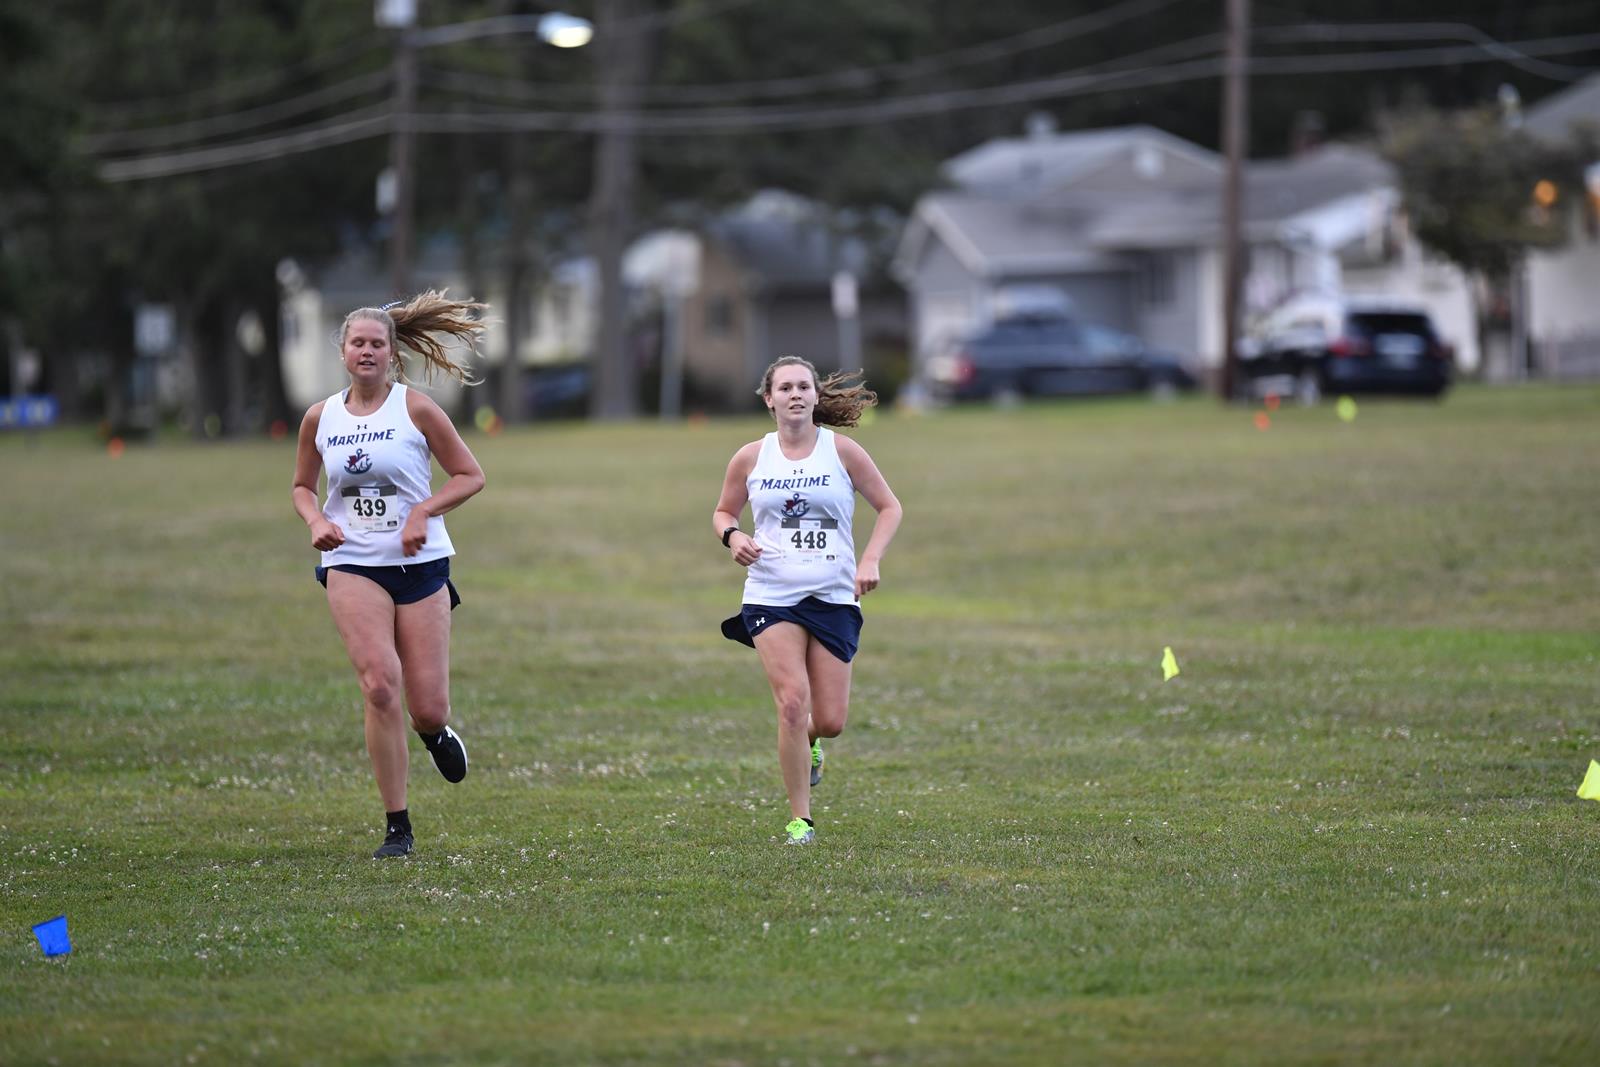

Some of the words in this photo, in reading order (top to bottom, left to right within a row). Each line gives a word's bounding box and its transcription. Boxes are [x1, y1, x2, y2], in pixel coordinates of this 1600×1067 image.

[327, 429, 395, 448] MARITIME
[760, 475, 830, 490] MARITIME
[353, 498, 386, 517] 439
[791, 531, 827, 549] 448
